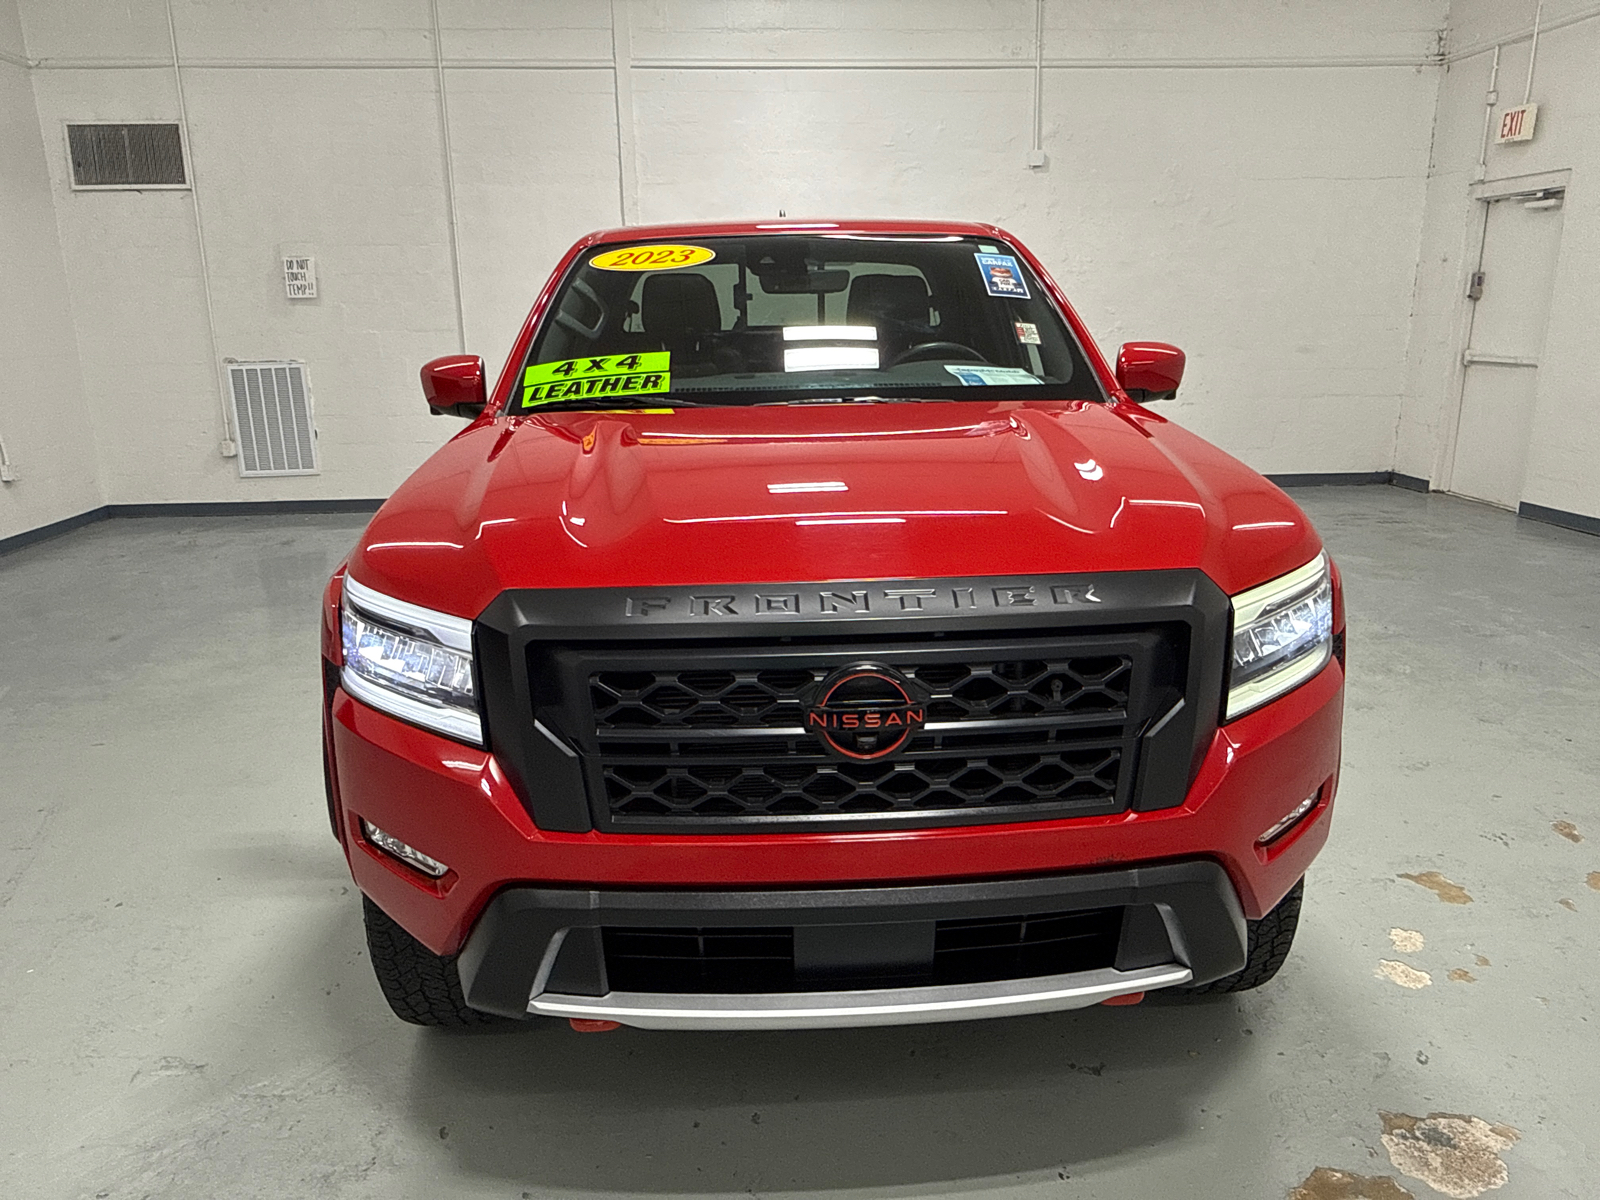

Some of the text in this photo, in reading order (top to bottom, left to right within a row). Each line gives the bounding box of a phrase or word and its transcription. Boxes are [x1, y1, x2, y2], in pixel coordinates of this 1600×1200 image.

[1500, 109, 1527, 139] EXIT
[285, 258, 310, 271] DO NOT
[609, 249, 696, 267] 2023
[285, 271, 307, 283] TOUCH
[287, 282, 314, 296] TEMP!!
[528, 374, 666, 402] LEATHER
[624, 583, 1103, 618] FRONTIER
[808, 708, 924, 728] NISSAN
